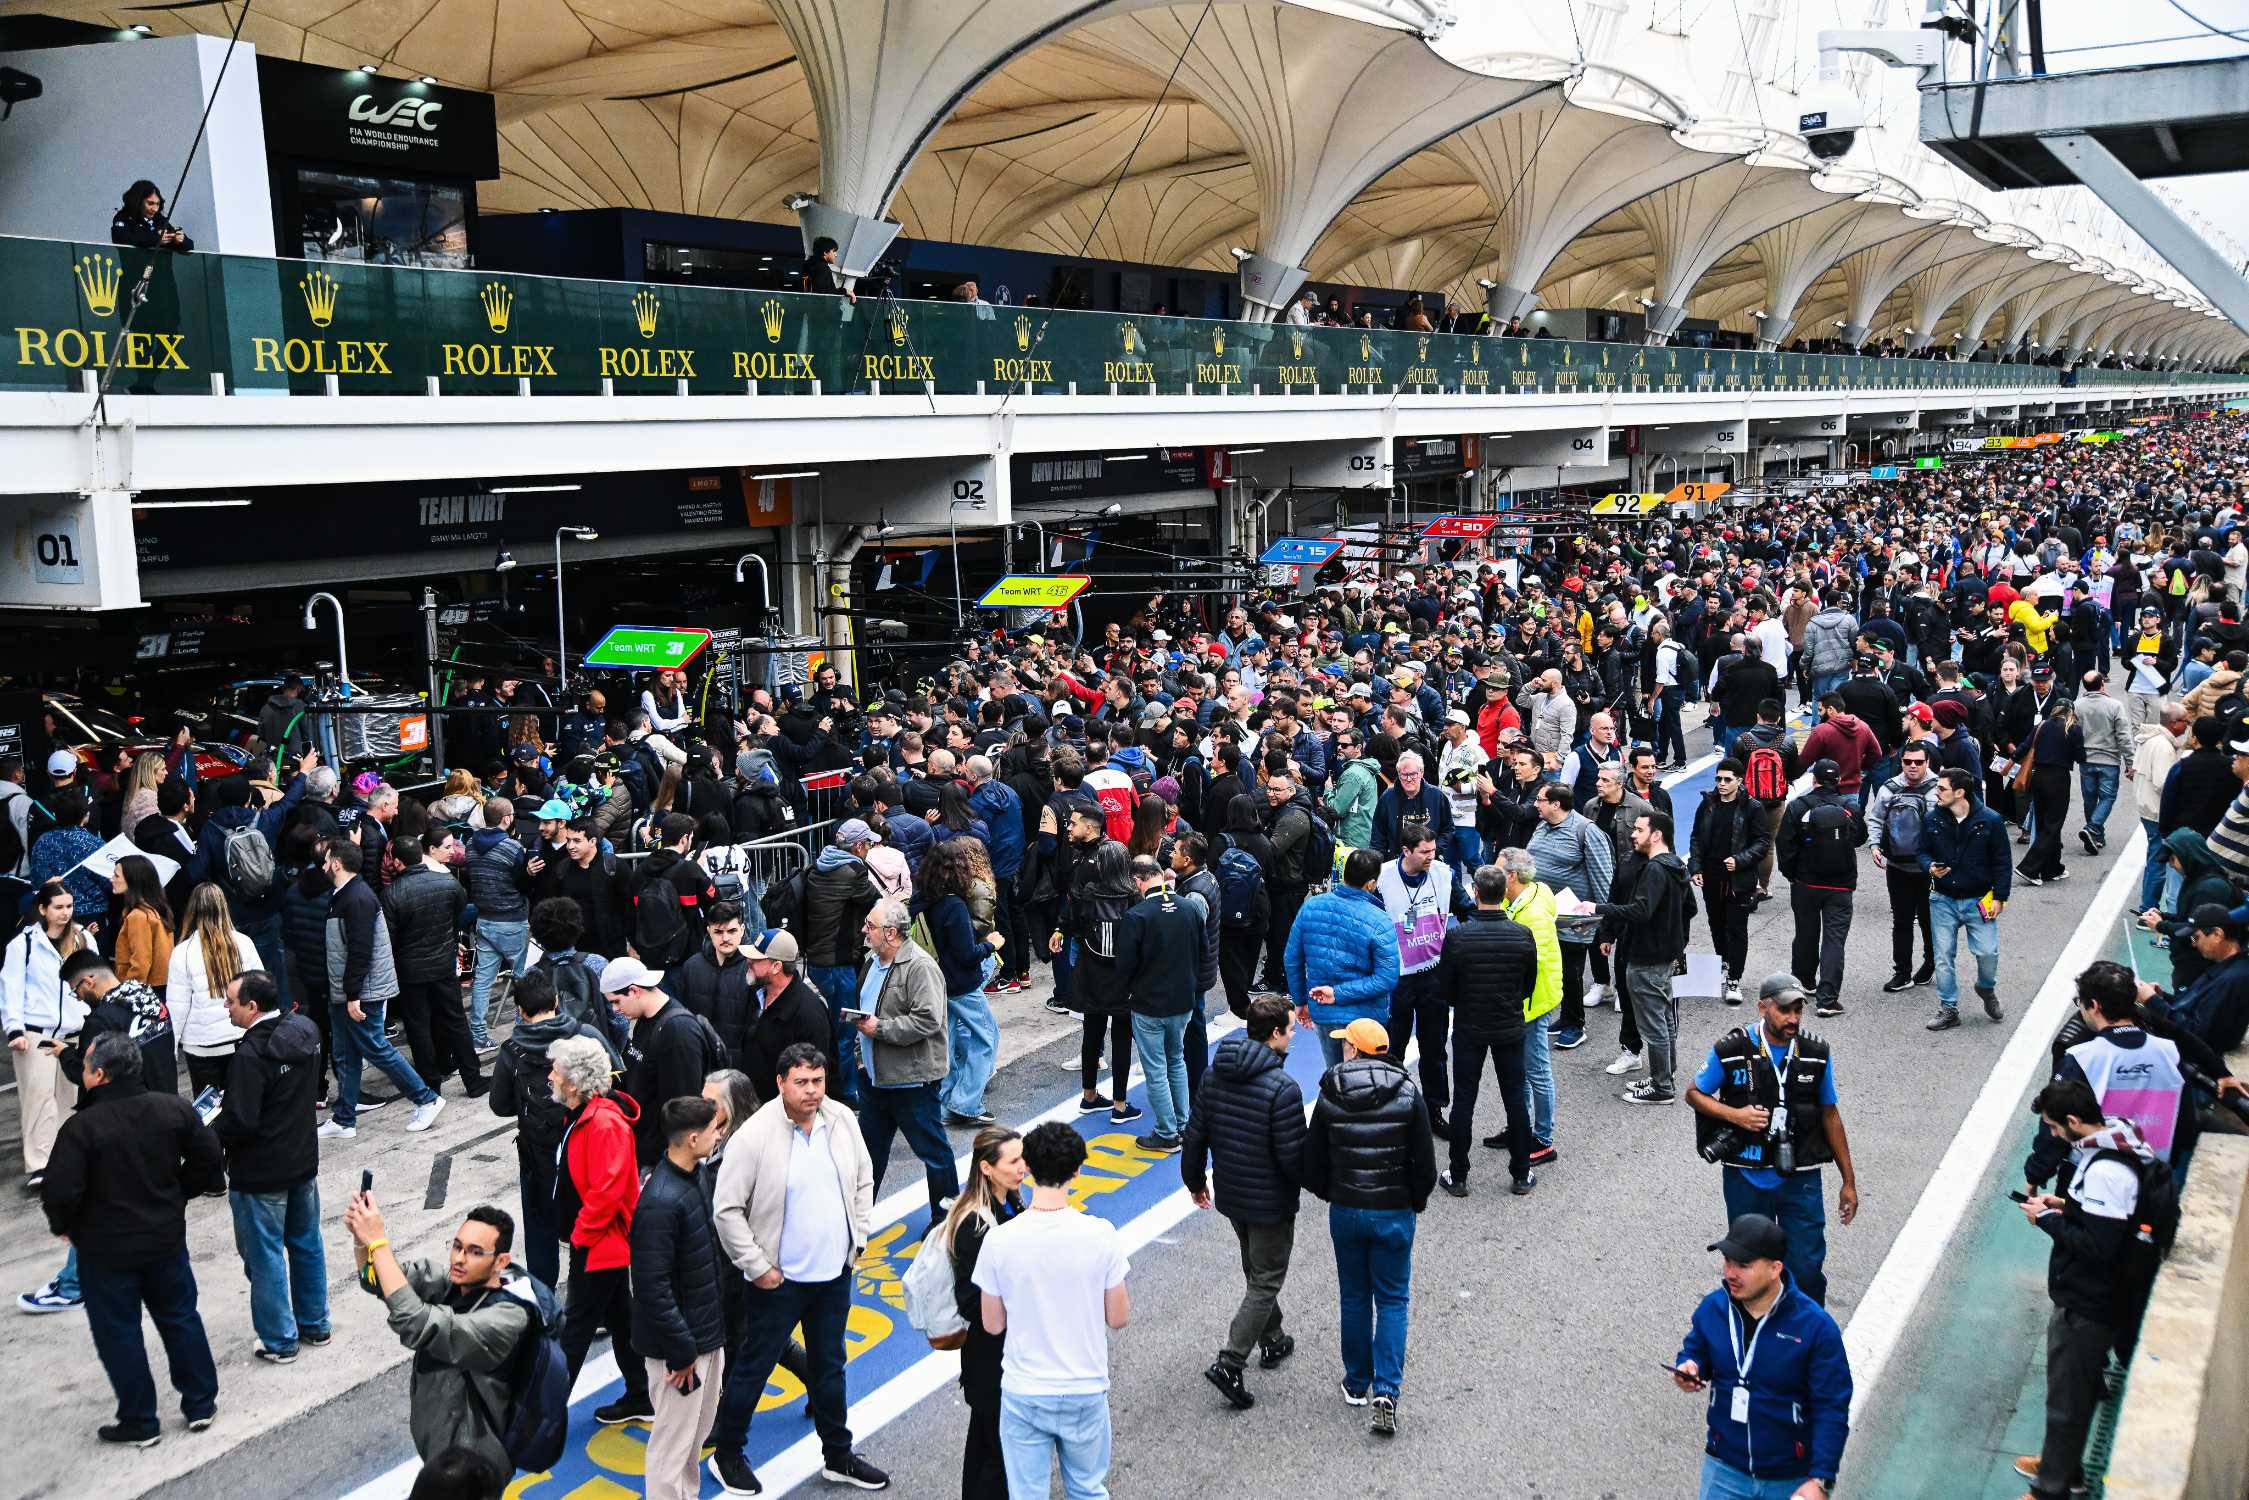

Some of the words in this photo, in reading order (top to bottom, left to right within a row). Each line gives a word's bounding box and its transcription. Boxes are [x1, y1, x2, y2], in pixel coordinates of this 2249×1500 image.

[349, 94, 443, 131] WEC
[350, 128, 363, 137] FIA
[364, 129, 393, 140] WORLD
[393, 133, 439, 147] ENDURANCE
[350, 137, 409, 150] CHAMPIONSHIP
[15, 327, 190, 370] ROLEX
[252, 337, 392, 374] ROLEX
[443, 343, 558, 377] ROLEX
[598, 347, 698, 378] ROLEX
[733, 351, 817, 380] ROLEX
[865, 354, 936, 381] ROLEX
[993, 358, 1054, 382] ROLEX
[1104, 361, 1156, 383] ROLEX
[1198, 363, 1242, 384] ROLEX
[1279, 366, 1317, 385] ROLEX
[1349, 367, 1382, 384] ROLEX
[1408, 368, 1438, 385] ROLEX
[1463, 370, 1489, 385] ROLEX
[1512, 371, 1536, 385] ROLEX
[1556, 371, 1578, 385] ROLEX
[1821, 421, 1836, 430] 06
[1896, 416, 1909, 424] 07
[1573, 439, 1594, 450] 04
[1717, 432, 1734, 441] 05
[1987, 438, 2001, 447] 93
[1956, 441, 1972, 450] 94
[1350, 455, 1376, 471] 03
[1879, 468, 1888, 477] 77
[954, 479, 984, 500] 02
[1684, 485, 1706, 500] 91
[419, 496, 465, 525] TEAM
[468, 494, 506, 522] WRT
[1615, 495, 1640, 512] 92
[1462, 523, 1483, 532] 20
[37, 533, 78, 567] 01
[1309, 546, 1327, 556] 15
[1000, 587, 1021, 595] Team
[1023, 587, 1042, 595] WRT
[609, 641, 633, 652] Team
[635, 643, 656, 653] WRT
[666, 641, 685, 655] 31
[400, 721, 427, 747] 31
[1407, 931, 1446, 948] MEDICA
[2115, 1064, 2154, 1074] WEC
